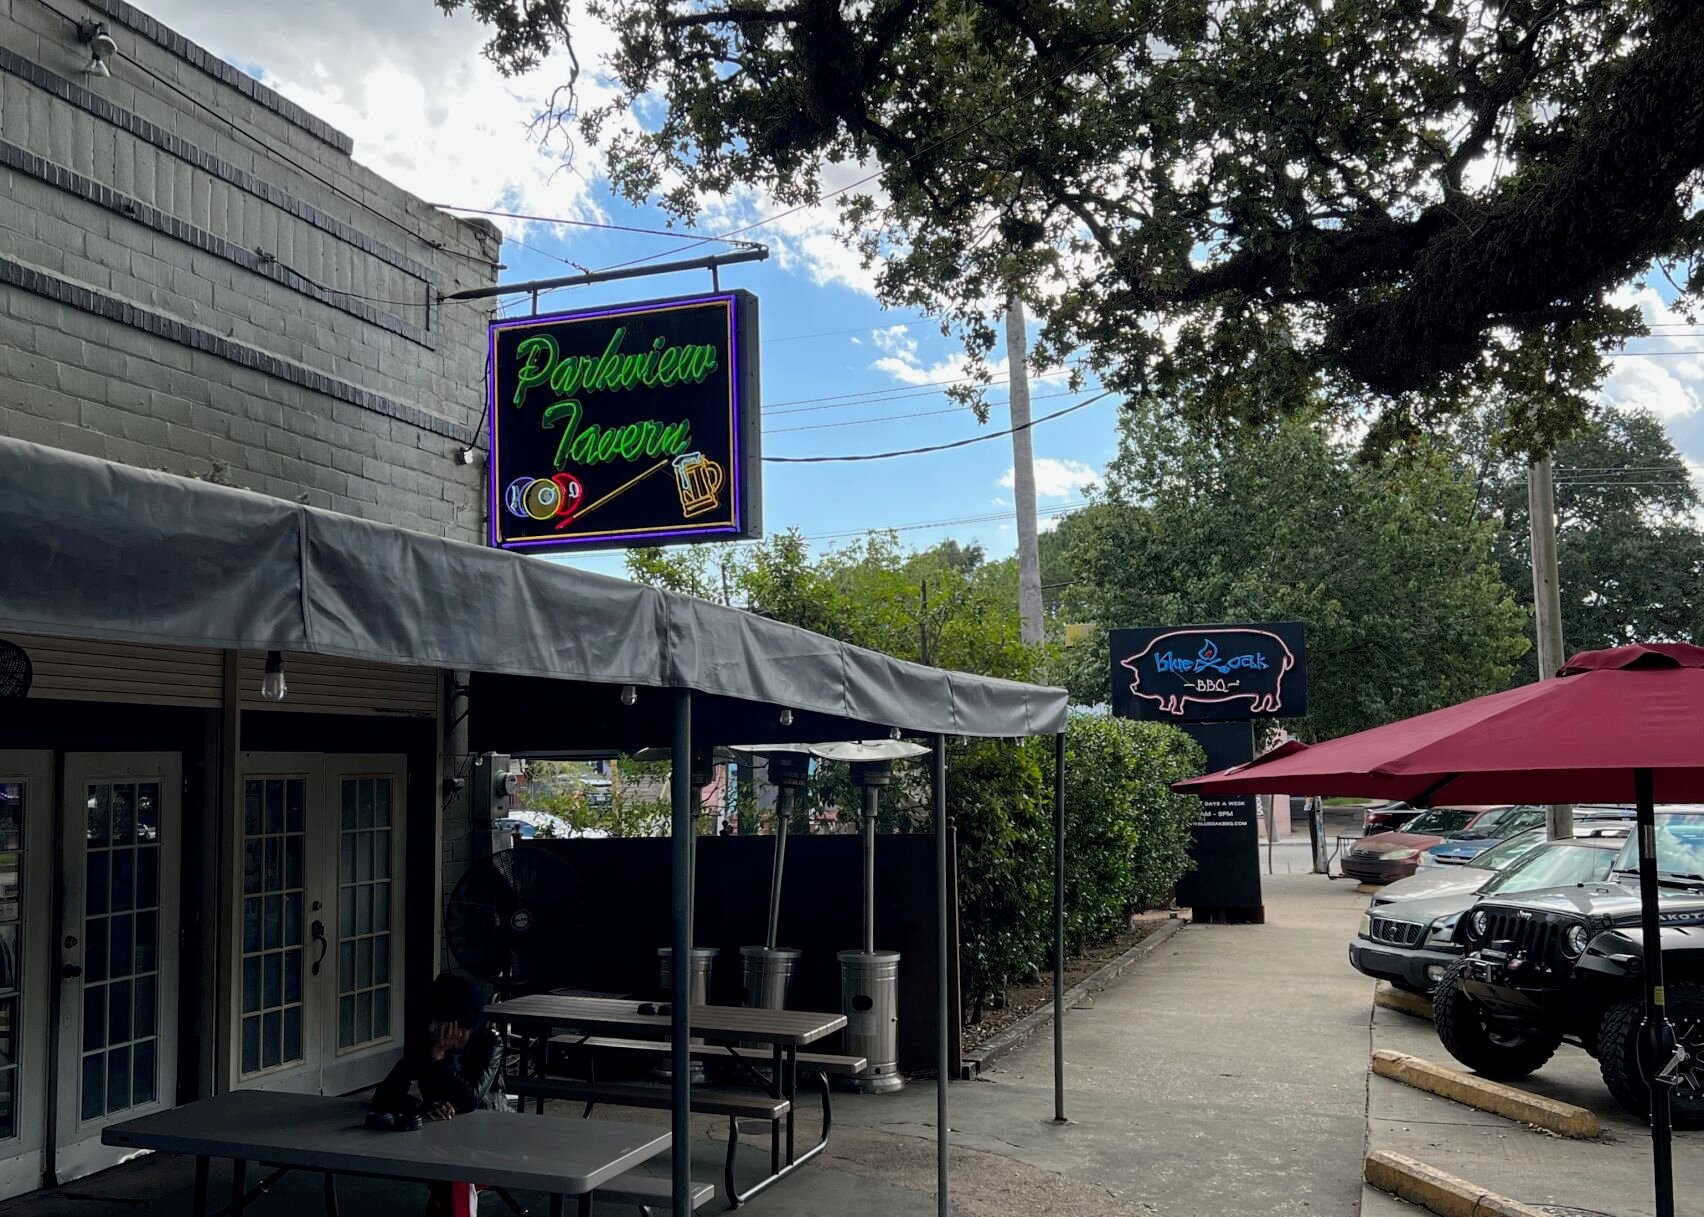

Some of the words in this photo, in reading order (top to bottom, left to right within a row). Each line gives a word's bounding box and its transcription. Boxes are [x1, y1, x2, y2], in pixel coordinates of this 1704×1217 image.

[513, 326, 718, 408] Parkview
[541, 398, 692, 471] Tavern
[1154, 651, 1193, 673] blue
[1227, 652, 1270, 671] oak
[1196, 678, 1230, 692] BBQ
